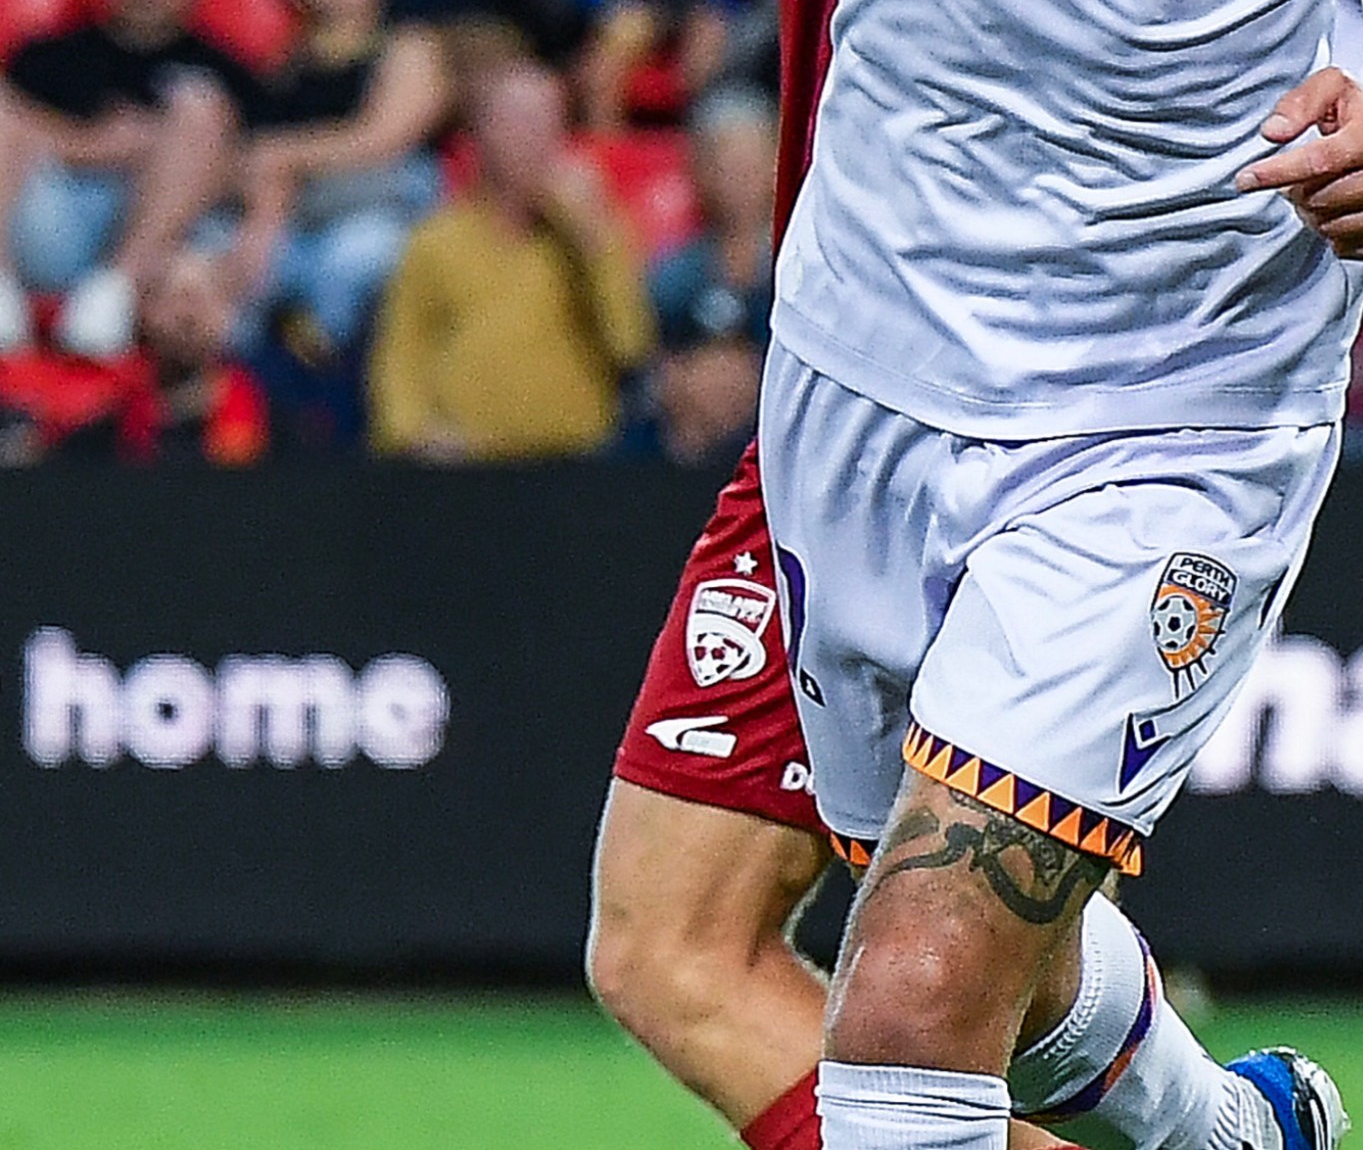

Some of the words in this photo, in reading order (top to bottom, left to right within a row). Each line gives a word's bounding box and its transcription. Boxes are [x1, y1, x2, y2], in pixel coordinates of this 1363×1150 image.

[1172, 571, 1227, 601] GLORY
[1180, 557, 1230, 588] PERTH
[22, 625, 452, 770] home
